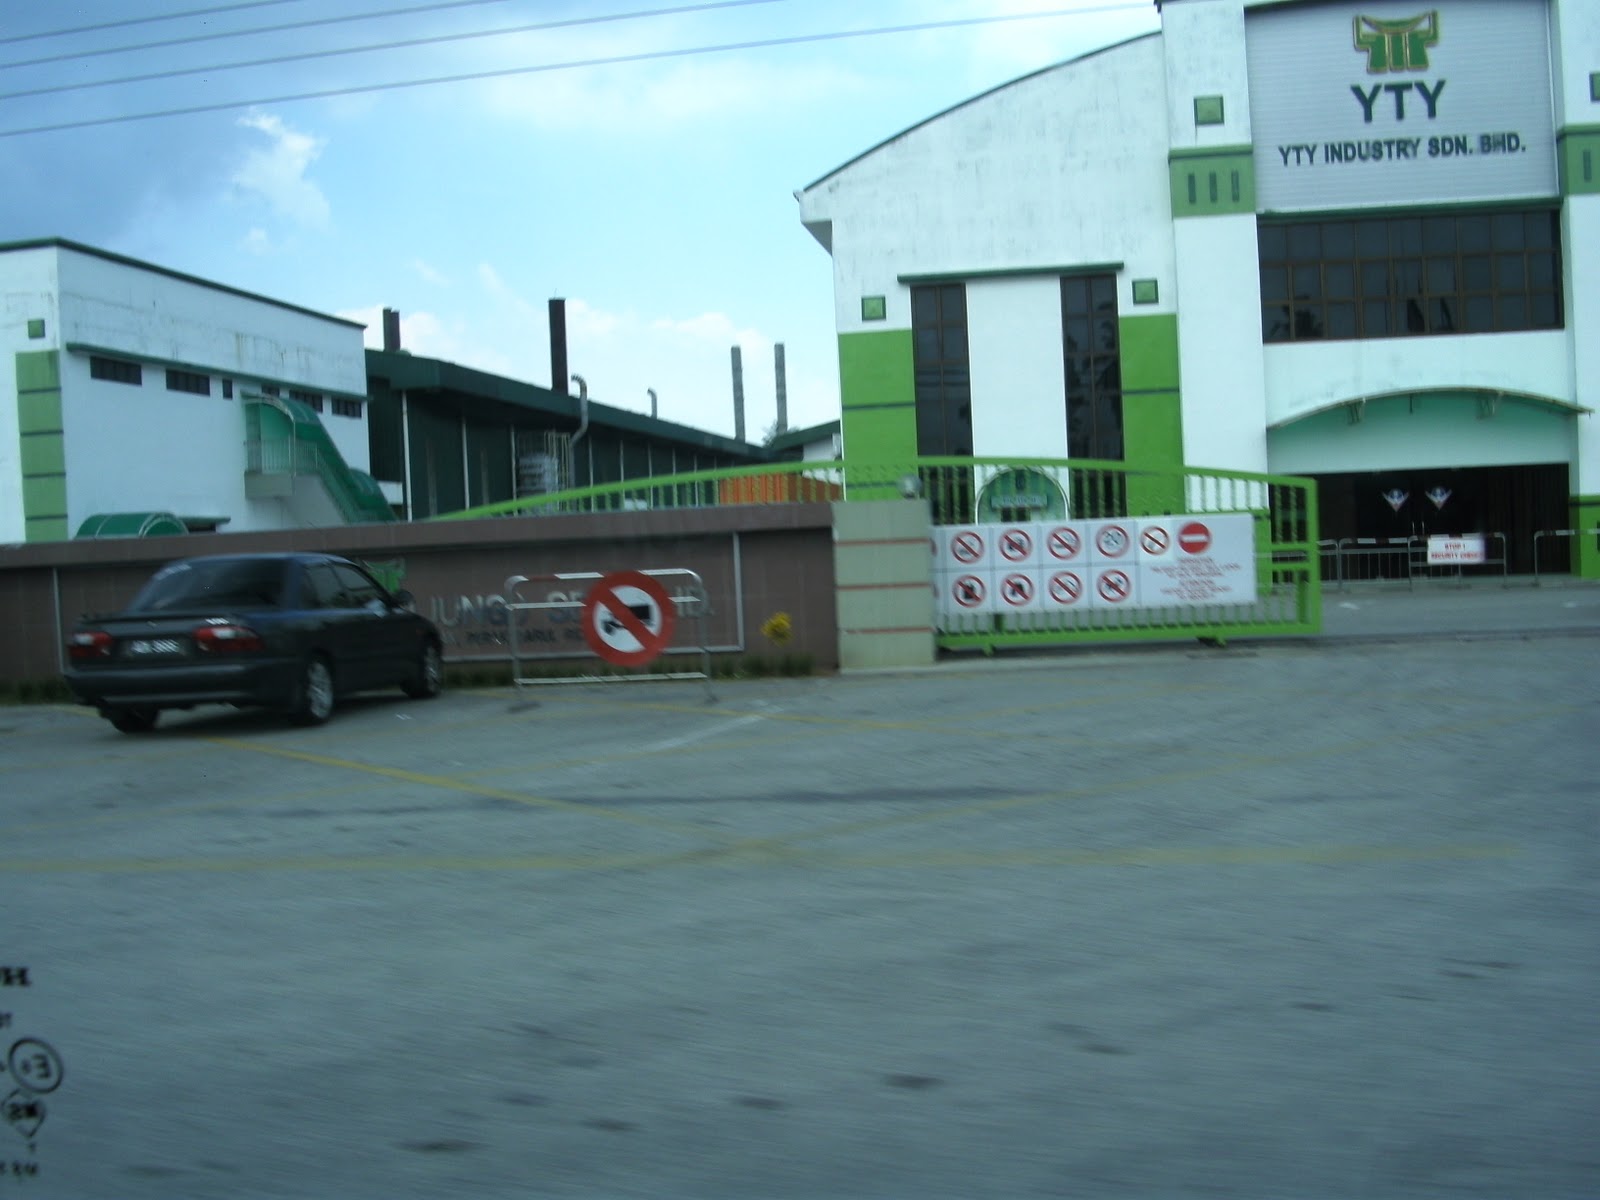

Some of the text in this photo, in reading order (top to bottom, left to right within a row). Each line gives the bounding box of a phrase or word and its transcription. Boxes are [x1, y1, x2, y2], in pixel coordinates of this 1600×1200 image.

[1350, 79, 1446, 123] YTY
[1278, 132, 1526, 166] YTY INDUSTRY SDN. BHD.
